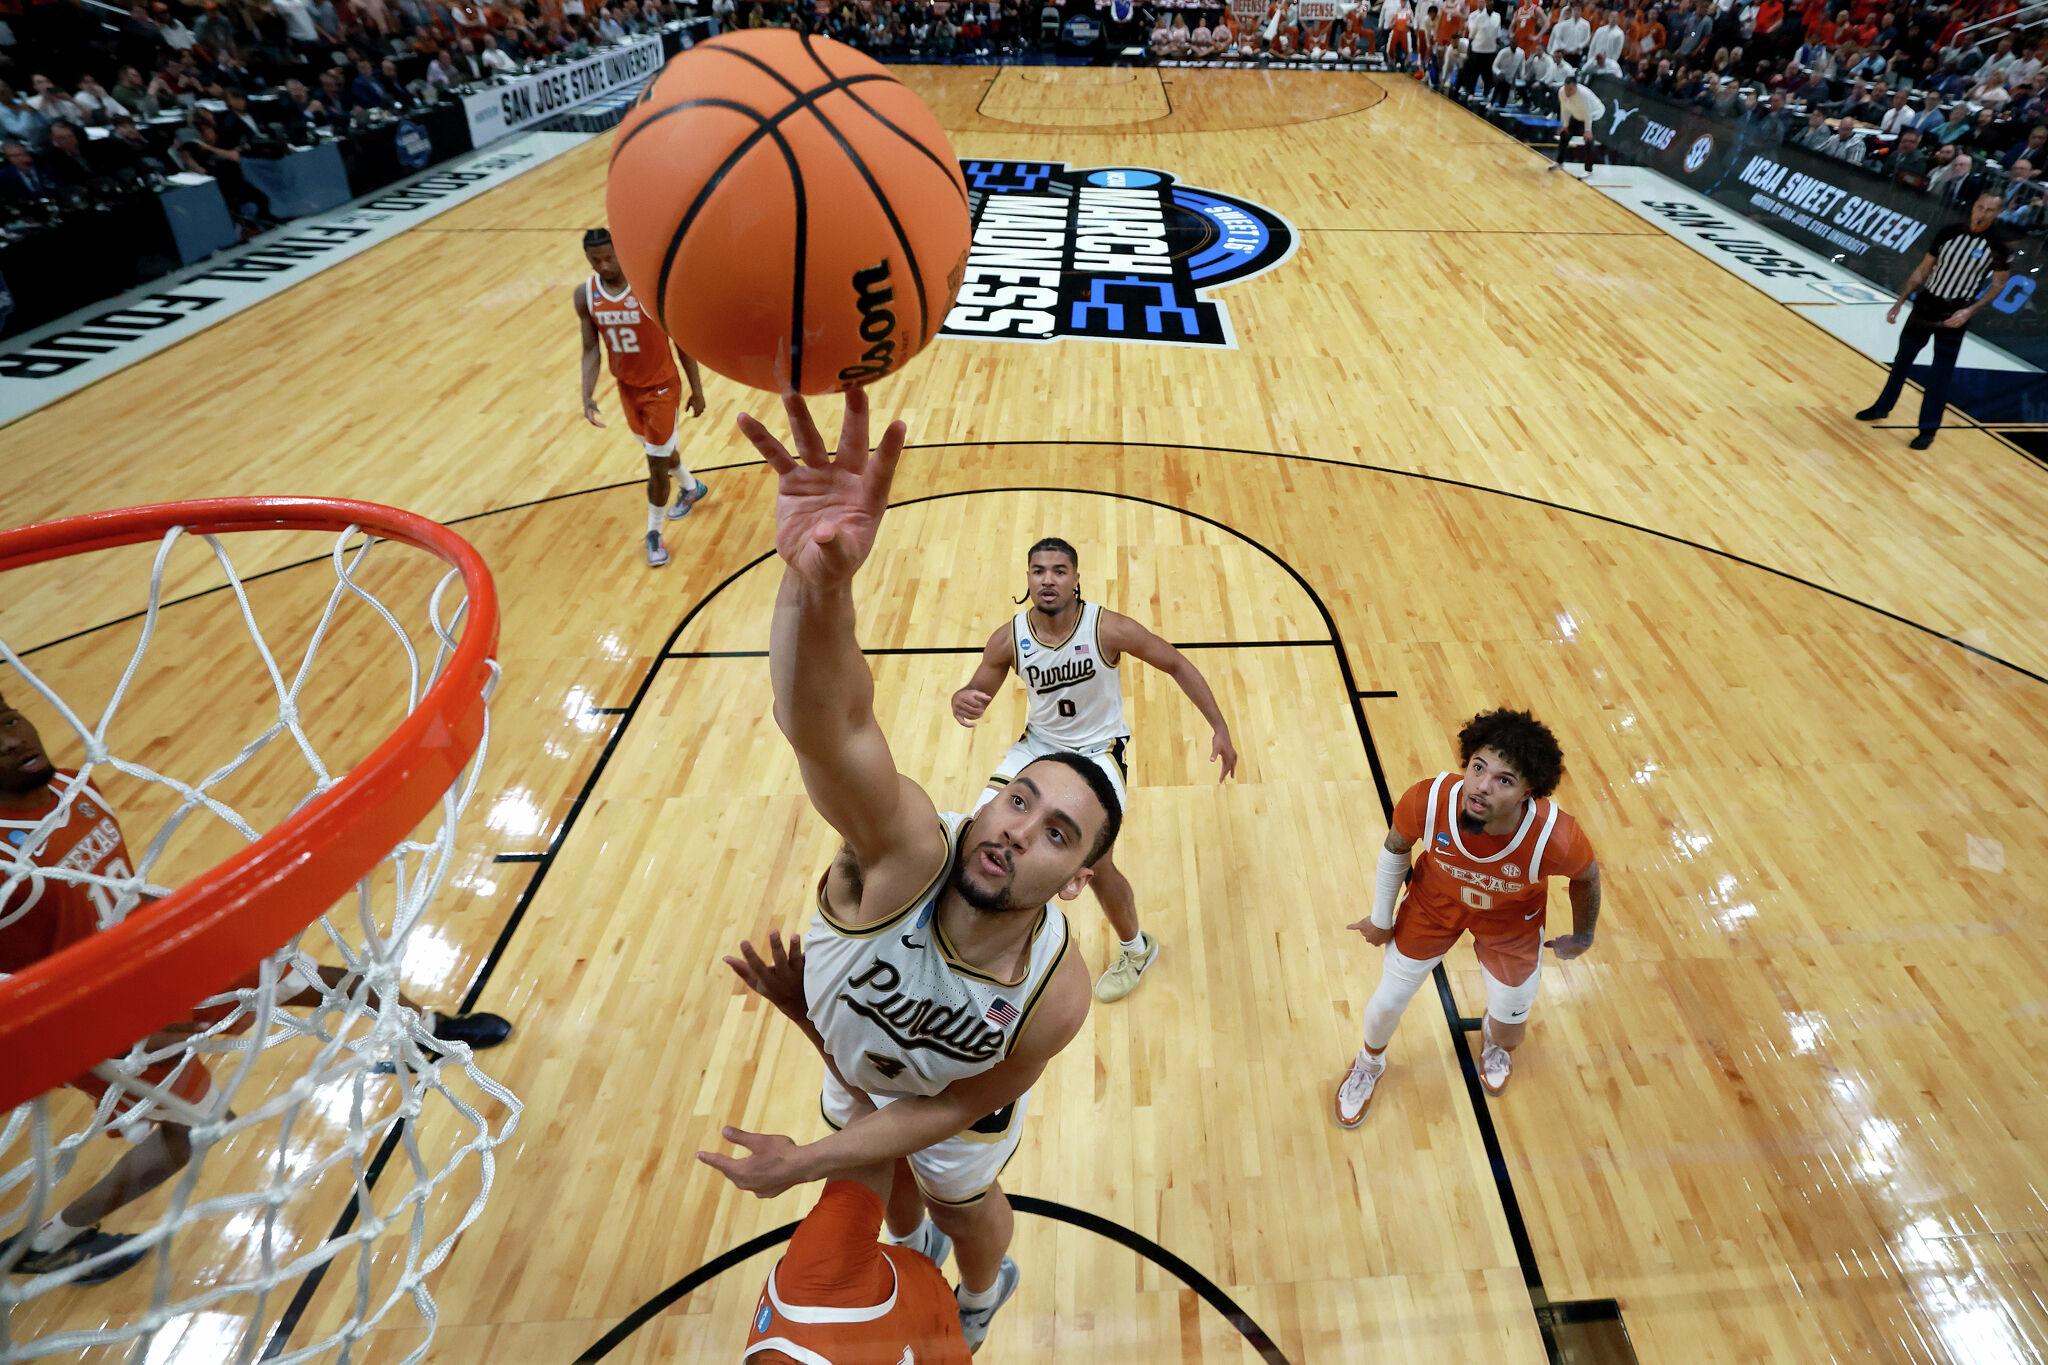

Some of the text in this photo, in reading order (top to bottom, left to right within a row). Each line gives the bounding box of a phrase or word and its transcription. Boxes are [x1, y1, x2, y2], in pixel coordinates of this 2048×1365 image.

[1301, 3, 1335, 17] DEFENSE
[501, 84, 534, 126] SAN
[535, 73, 570, 114] JOSE
[569, 60, 606, 100] STATE
[603, 40, 664, 86] UNIVERSITY
[1640, 120, 1677, 151] TEXAS
[1686, 136, 1711, 170] SEC
[357, 170, 501, 211] ROAD
[1738, 155, 1928, 254] NCAA SWEET SIXTEEN
[1073, 187, 1173, 275] MARCH
[1203, 206, 1260, 251] SWEET 16
[1640, 200, 1832, 281] SAN JOSE
[1779, 205, 1797, 222] SAN
[1791, 212, 1813, 230] JOSE
[1807, 219, 1832, 237] STATE
[1826, 227, 1871, 256] UNIVERSITY
[178, 225, 374, 286] FINAL
[943, 194, 1069, 335] MADNESS
[0, 293, 226, 379] FOUR
[594, 310, 641, 325] TEXAS
[838, 257, 897, 389] lson
[606, 327, 641, 353] 12
[1025, 657, 1096, 696] Purdue
[1057, 698, 1077, 718] 0
[1433, 857, 1524, 893] TEXAS
[1502, 863, 1521, 877] SEC
[1460, 885, 1493, 910] 0
[840, 956, 1005, 1063] Purdue
